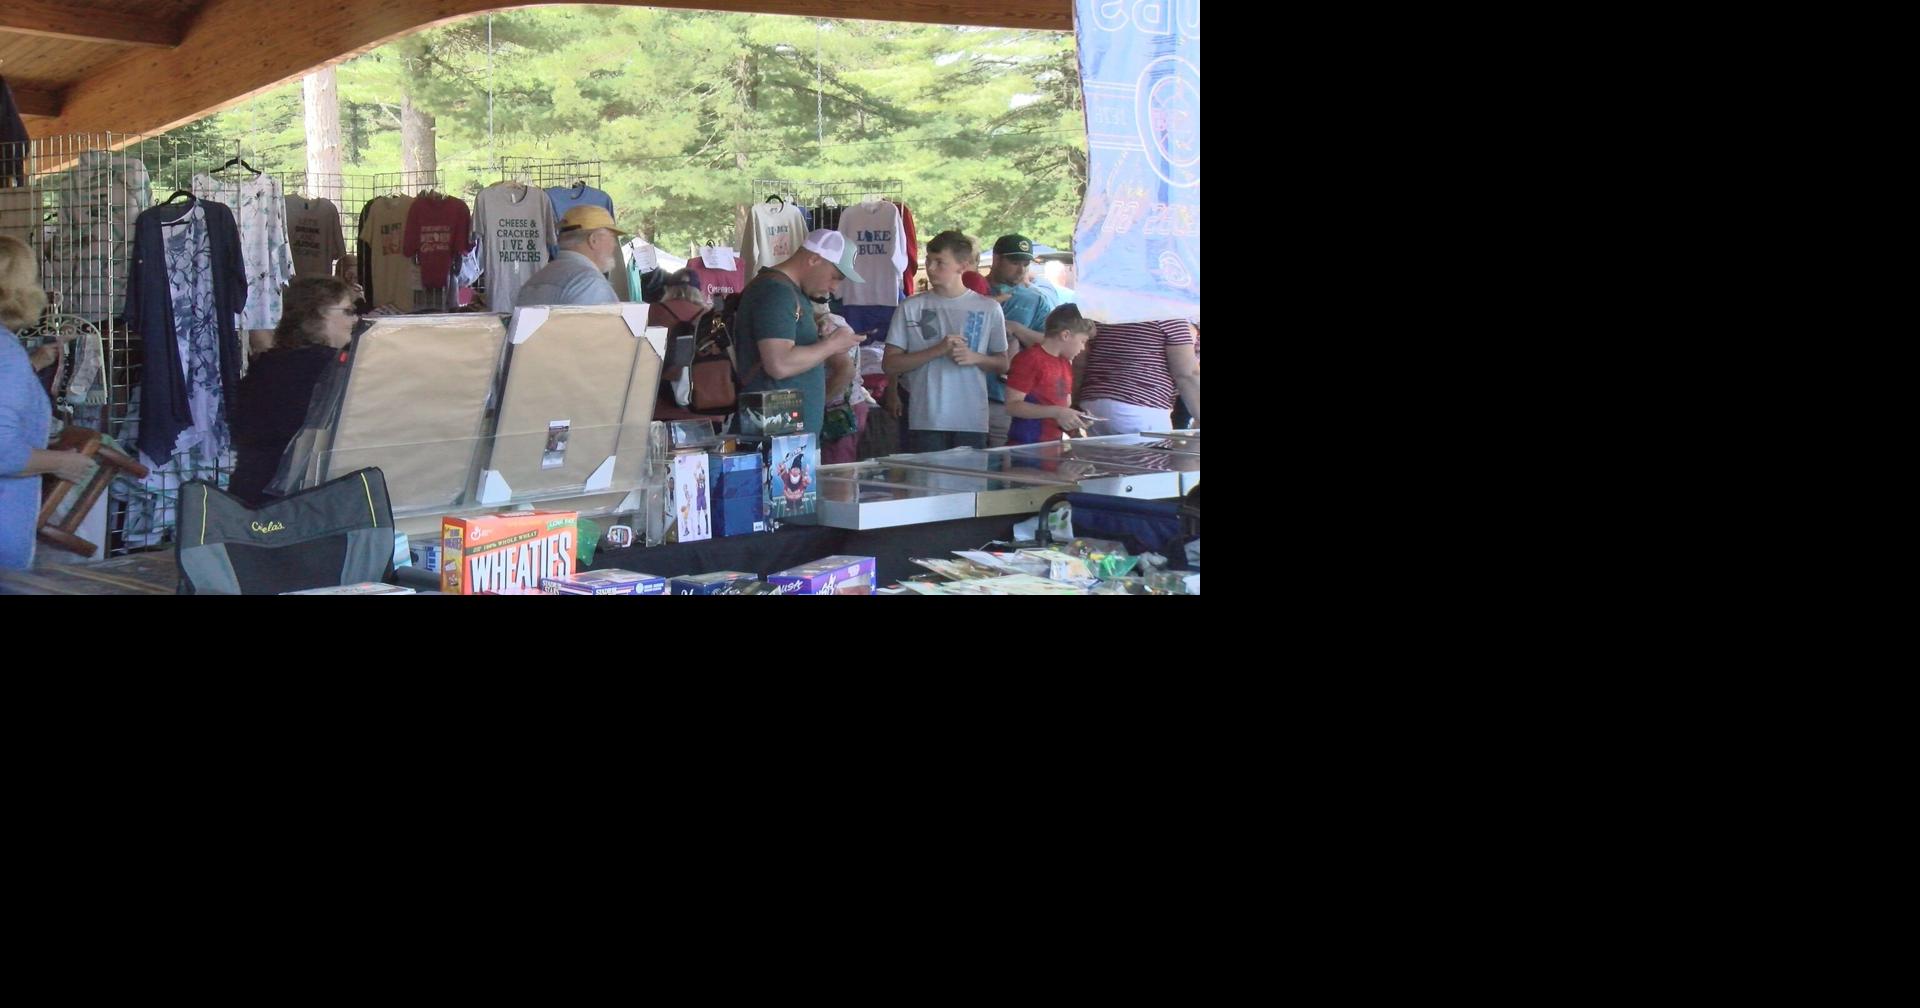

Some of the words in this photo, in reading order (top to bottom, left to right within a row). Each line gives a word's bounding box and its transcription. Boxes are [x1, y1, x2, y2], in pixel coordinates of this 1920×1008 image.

[498, 218, 528, 228] CHEESE
[530, 219, 537, 228] &
[496, 229, 540, 239] CRACKERS
[856, 230, 892, 242] LKE
[527, 239, 537, 251] &
[857, 243, 888, 256] BUM.
[498, 250, 541, 262] PACKERS
[251, 521, 285, 534] Cela's
[497, 537, 518, 547] WHOLE
[518, 530, 538, 541] WHEAT
[470, 531, 572, 593] WHEATIES
